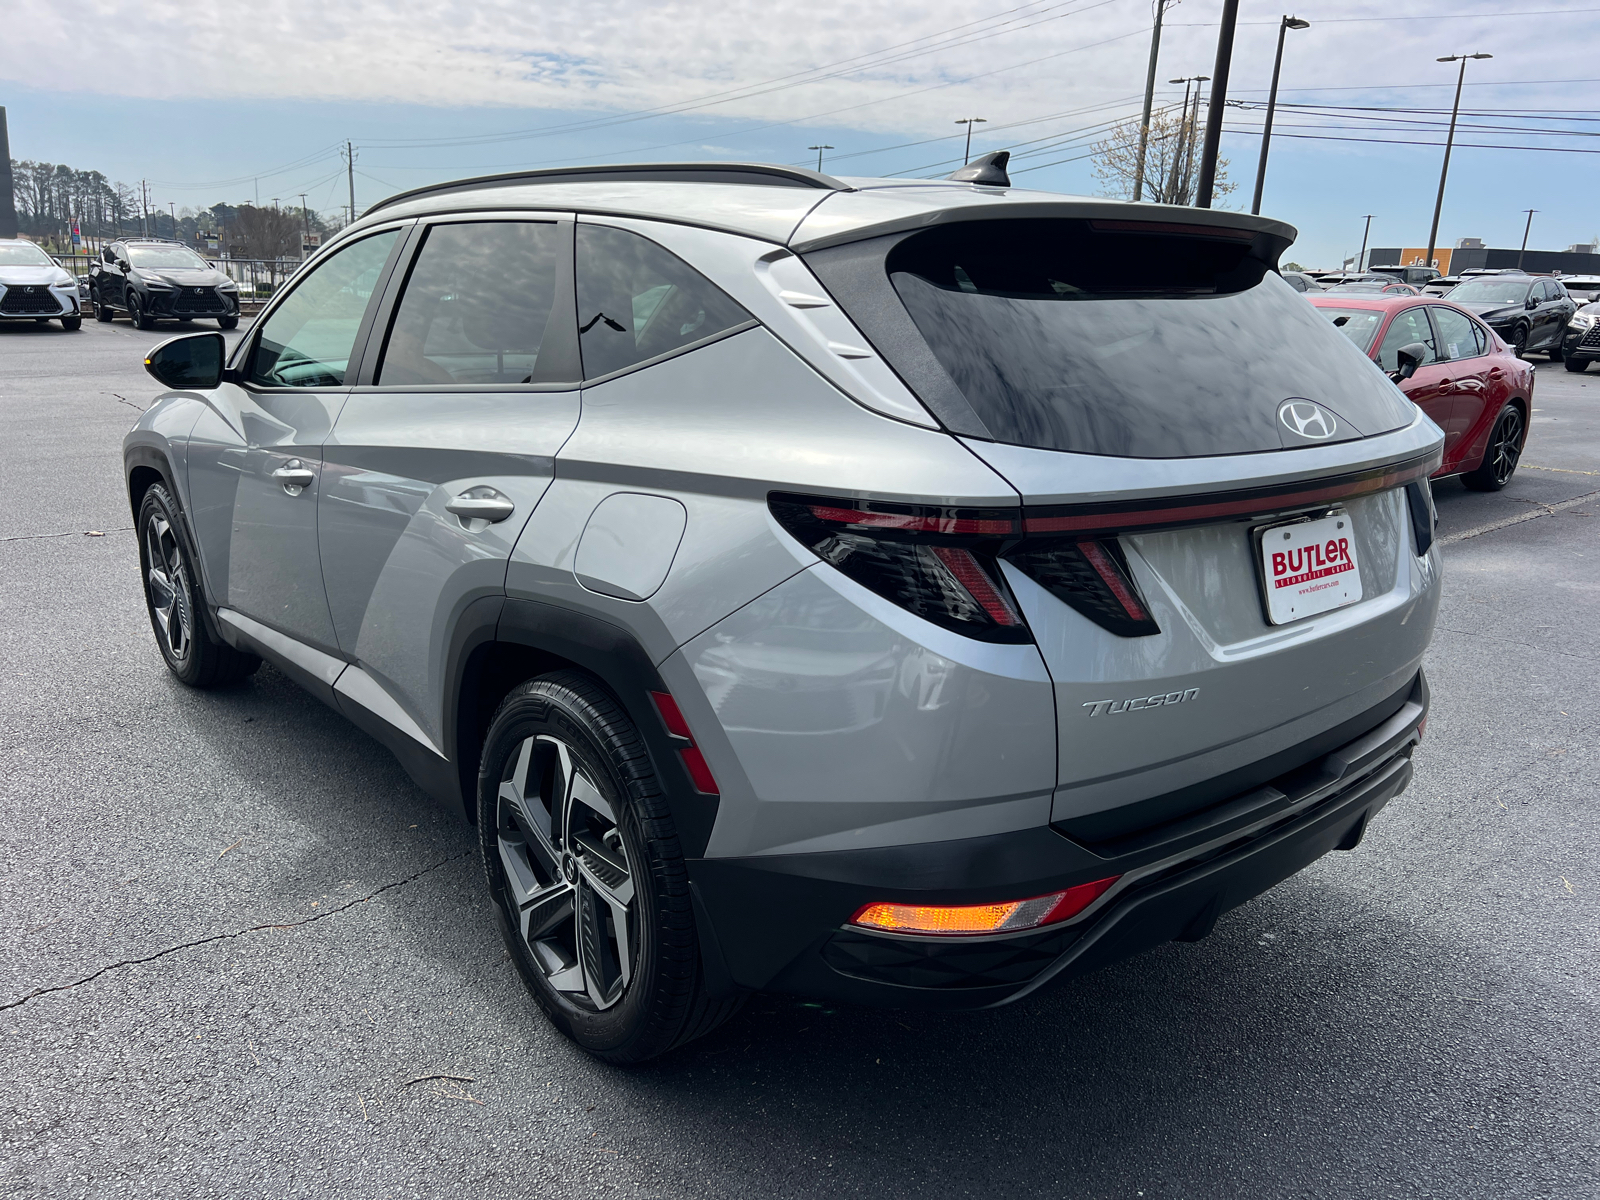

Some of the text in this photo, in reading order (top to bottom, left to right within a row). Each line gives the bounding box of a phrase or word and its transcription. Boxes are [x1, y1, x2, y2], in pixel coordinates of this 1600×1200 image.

[1409, 255, 1439, 269] Jep
[1331, 562, 1354, 574] GROUP
[1298, 580, 1340, 595] www.butlercars.com
